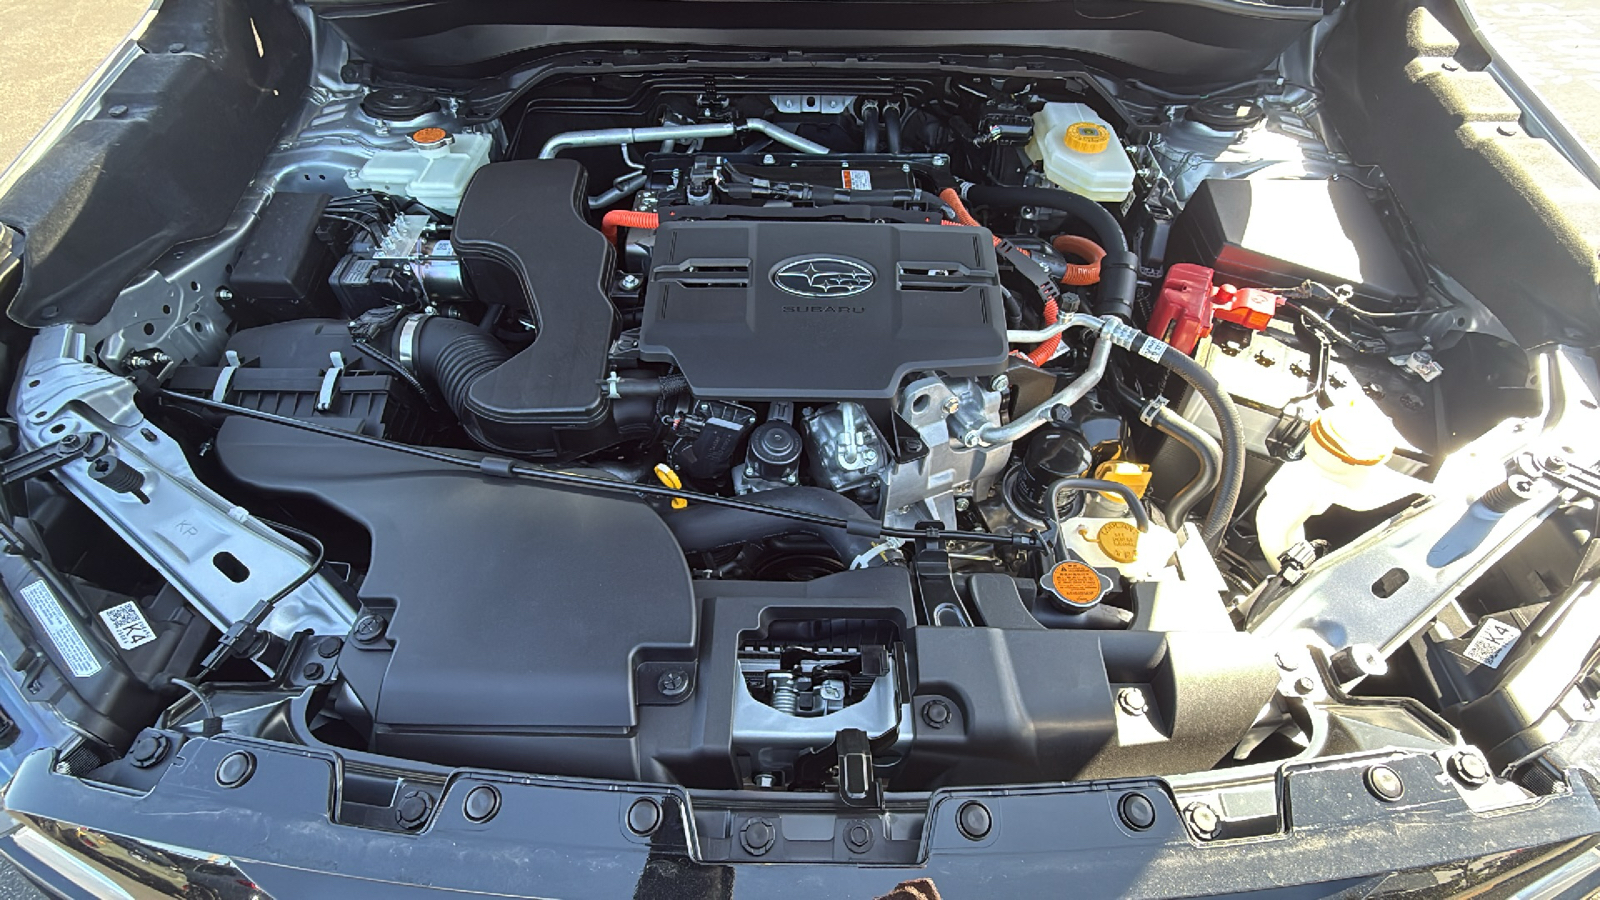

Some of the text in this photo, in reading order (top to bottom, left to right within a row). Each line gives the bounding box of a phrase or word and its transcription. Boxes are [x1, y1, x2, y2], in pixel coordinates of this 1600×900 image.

[782, 305, 865, 314] SUBARU
[122, 622, 147, 644] K4
[1484, 624, 1510, 646] K4
